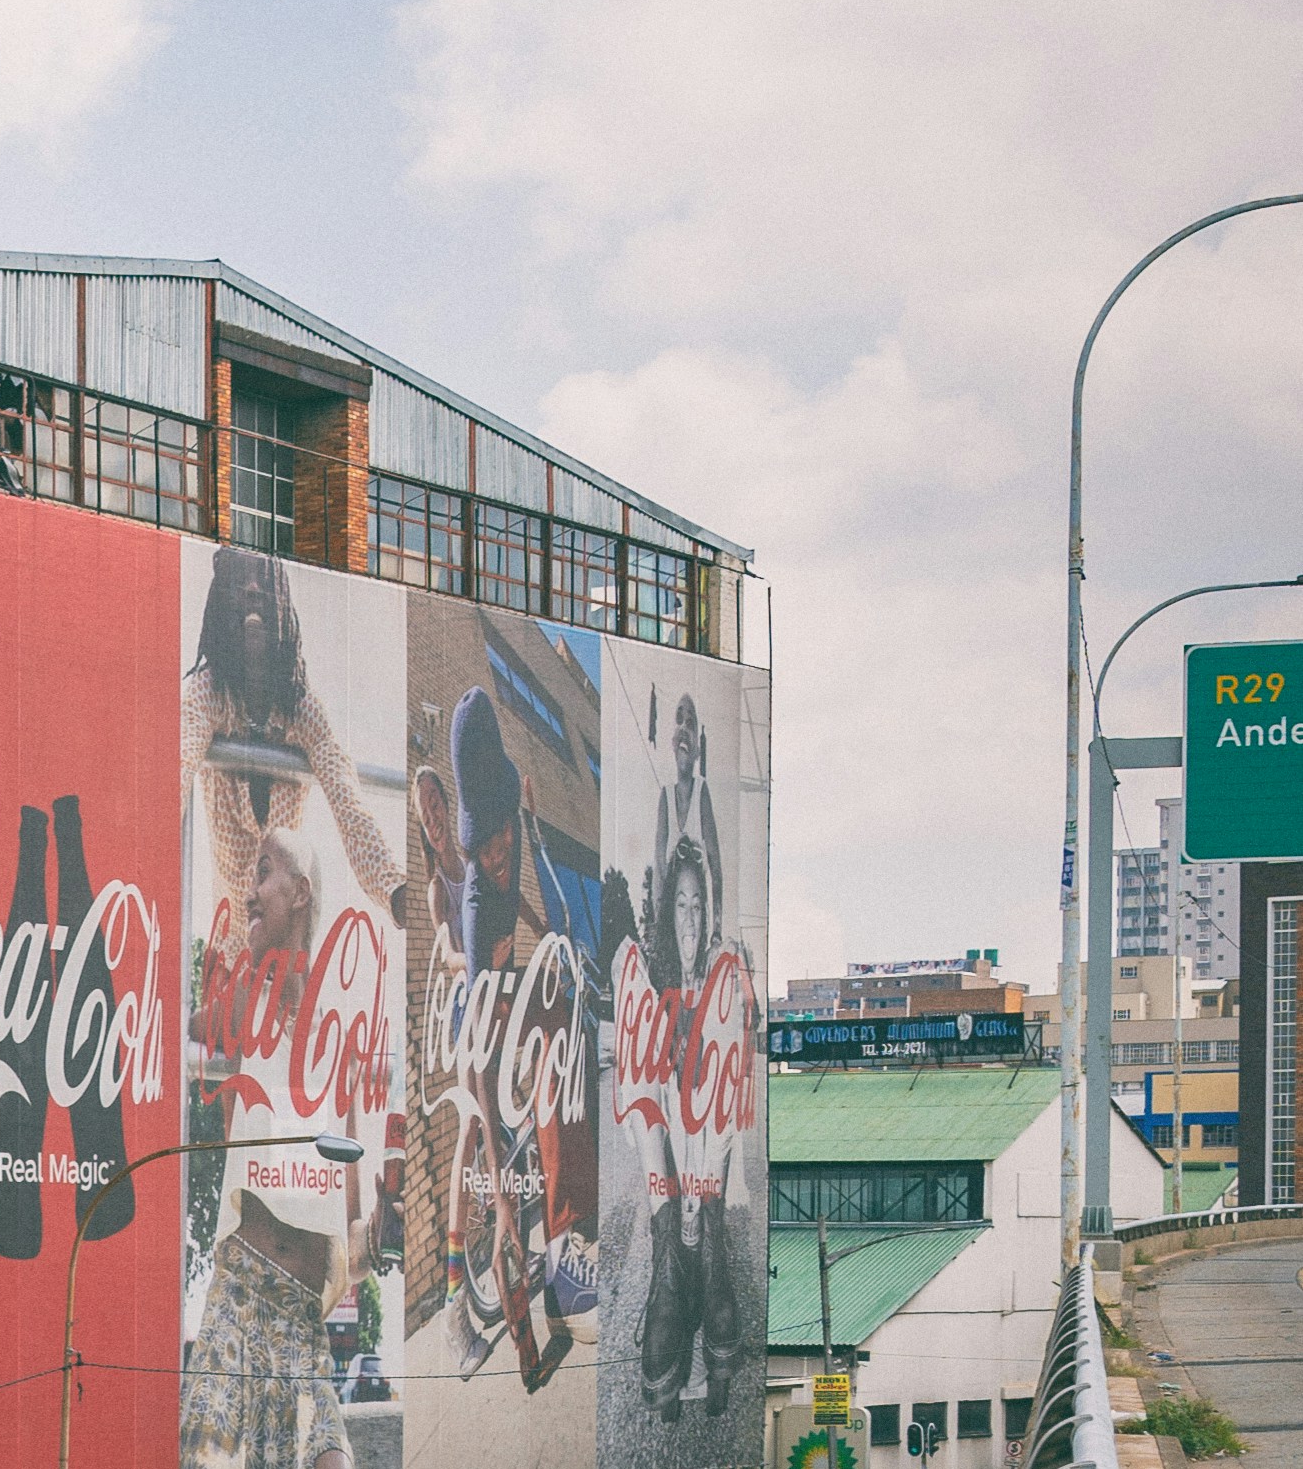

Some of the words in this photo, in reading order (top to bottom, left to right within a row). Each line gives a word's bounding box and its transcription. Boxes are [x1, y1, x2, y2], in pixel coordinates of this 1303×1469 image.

[1216, 672, 1285, 704] R29
[198, 897, 389, 1121] Coca-Cola
[419, 920, 587, 1131] Coca-Cola
[611, 942, 757, 1137] Coca-Cola
[49, 1154, 108, 1191] Magic
[248, 1161, 285, 1189] Real
[291, 1162, 342, 1196] Magic
[462, 1166, 496, 1193] Real
[500, 1168, 545, 1199] Magic
[649, 1172, 679, 1198] Real
[682, 1173, 721, 1204] Magic
